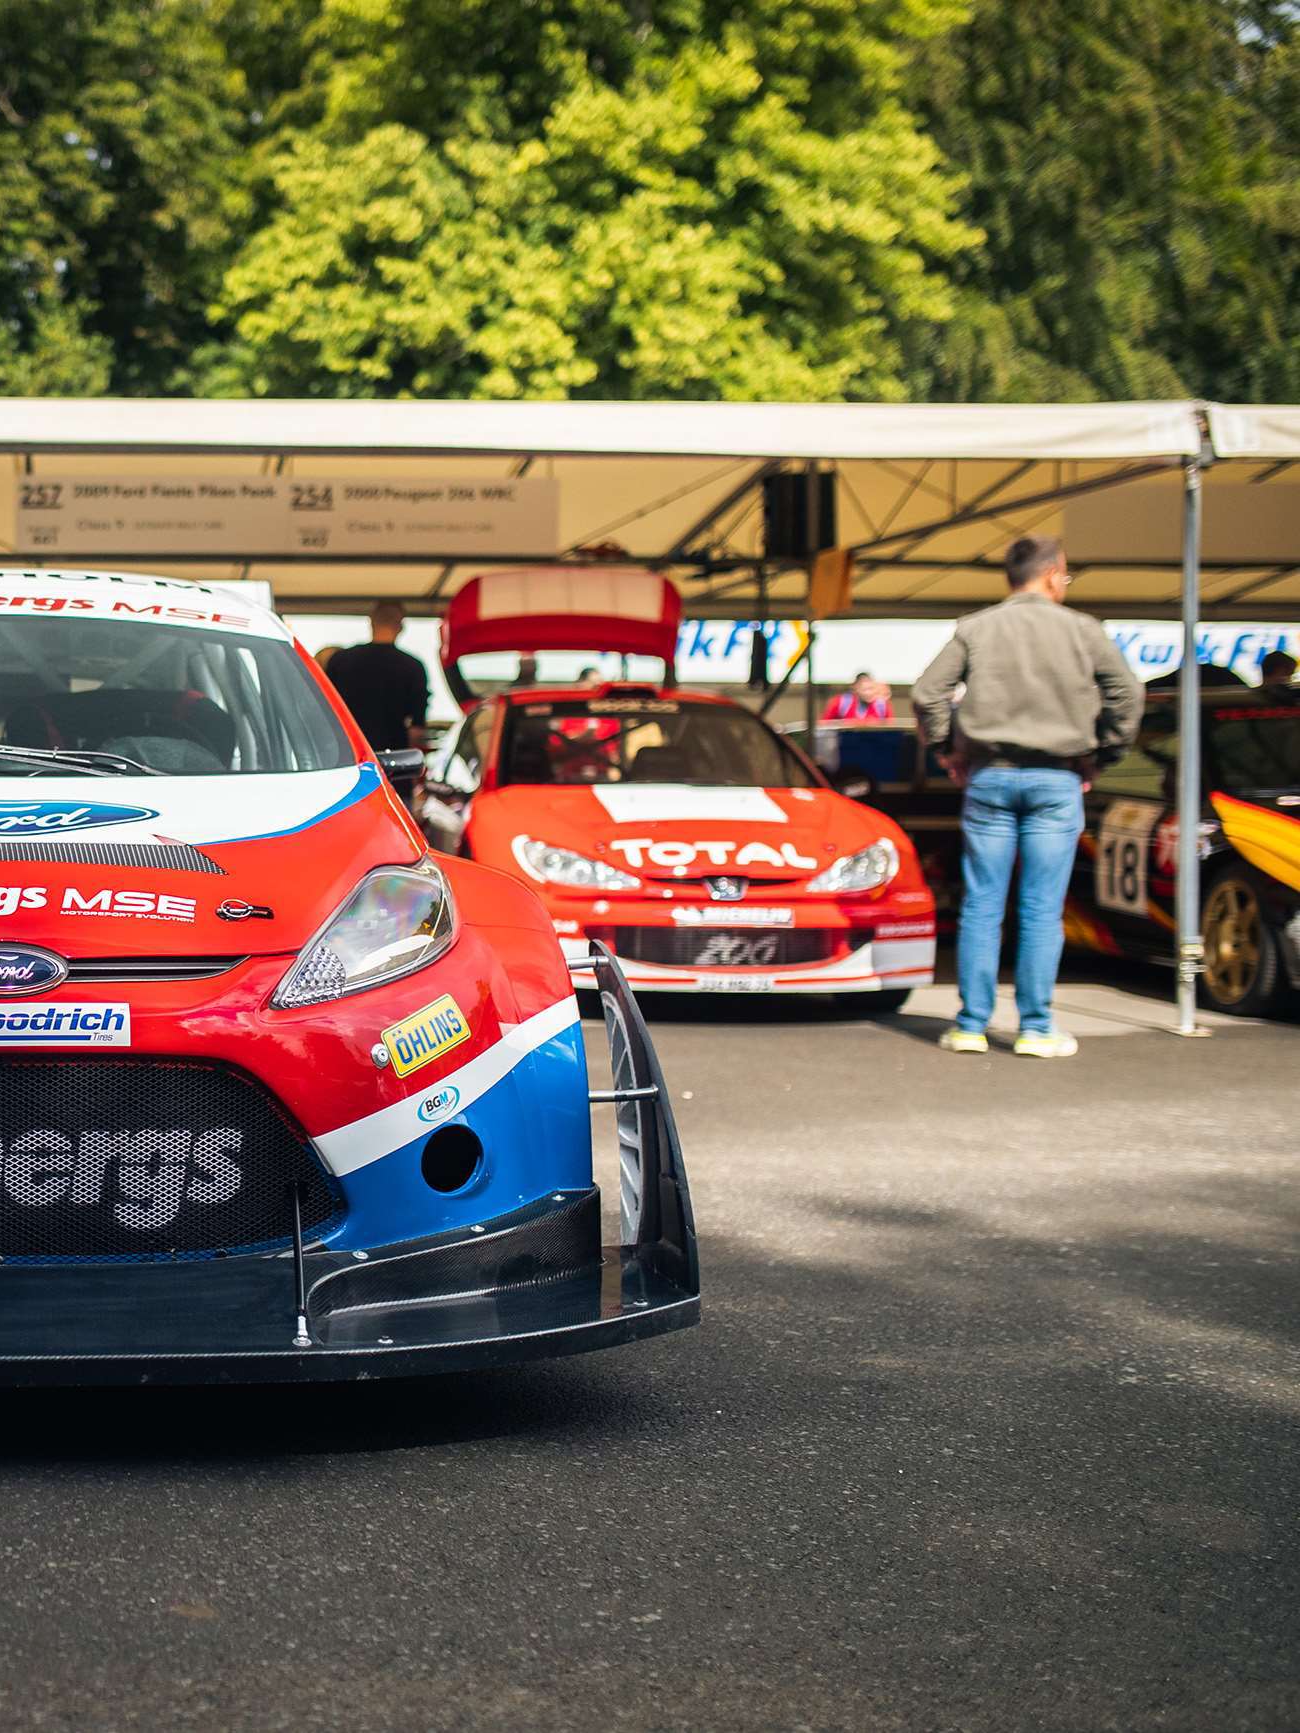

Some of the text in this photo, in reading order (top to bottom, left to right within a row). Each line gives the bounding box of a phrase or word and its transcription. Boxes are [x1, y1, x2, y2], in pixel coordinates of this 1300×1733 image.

[21, 484, 64, 507] 257
[113, 485, 147, 498] Ford
[151, 484, 193, 498] Fiesta
[197, 484, 237, 497] Pikes
[241, 484, 277, 497] Peak
[290, 485, 333, 508] 254
[383, 485, 444, 503] Peugeot
[112, 601, 251, 628] MSE
[610, 838, 818, 869] TOTAL
[1105, 838, 1139, 903] 18
[61, 887, 197, 918] MSE
[60, 910, 196, 924] MOTORSPORT EVOLUTION
[92, 1031, 114, 1042] Tires
[392, 1008, 462, 1065] ÖHLINS
[425, 1091, 449, 1112] BGM
